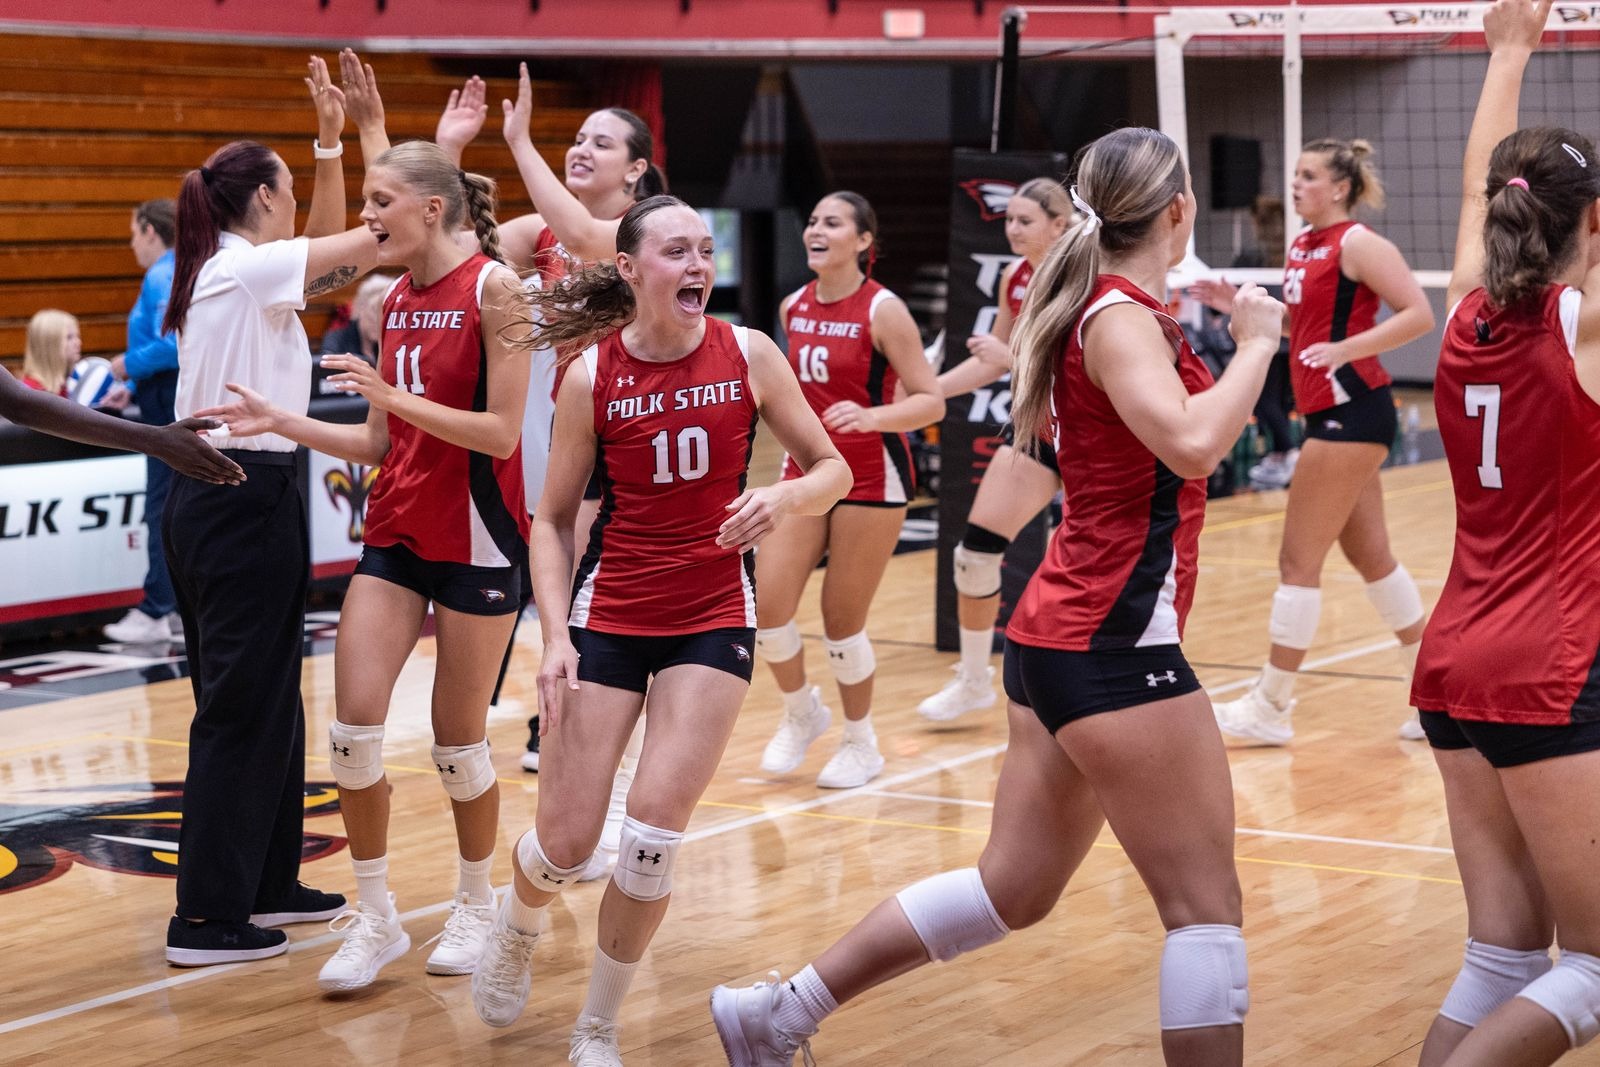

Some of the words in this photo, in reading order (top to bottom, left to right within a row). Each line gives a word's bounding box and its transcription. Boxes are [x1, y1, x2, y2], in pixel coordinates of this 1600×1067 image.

[410, 310, 465, 329] STATE
[790, 316, 817, 334] POLK
[817, 320, 863, 339] STATE
[395, 344, 425, 394] 11
[798, 343, 830, 384] 16
[607, 392, 665, 421] POLK
[674, 380, 742, 411] STATE
[651, 426, 710, 485] 10
[1464, 384, 1503, 489] 7
[79, 491, 147, 531] ST
